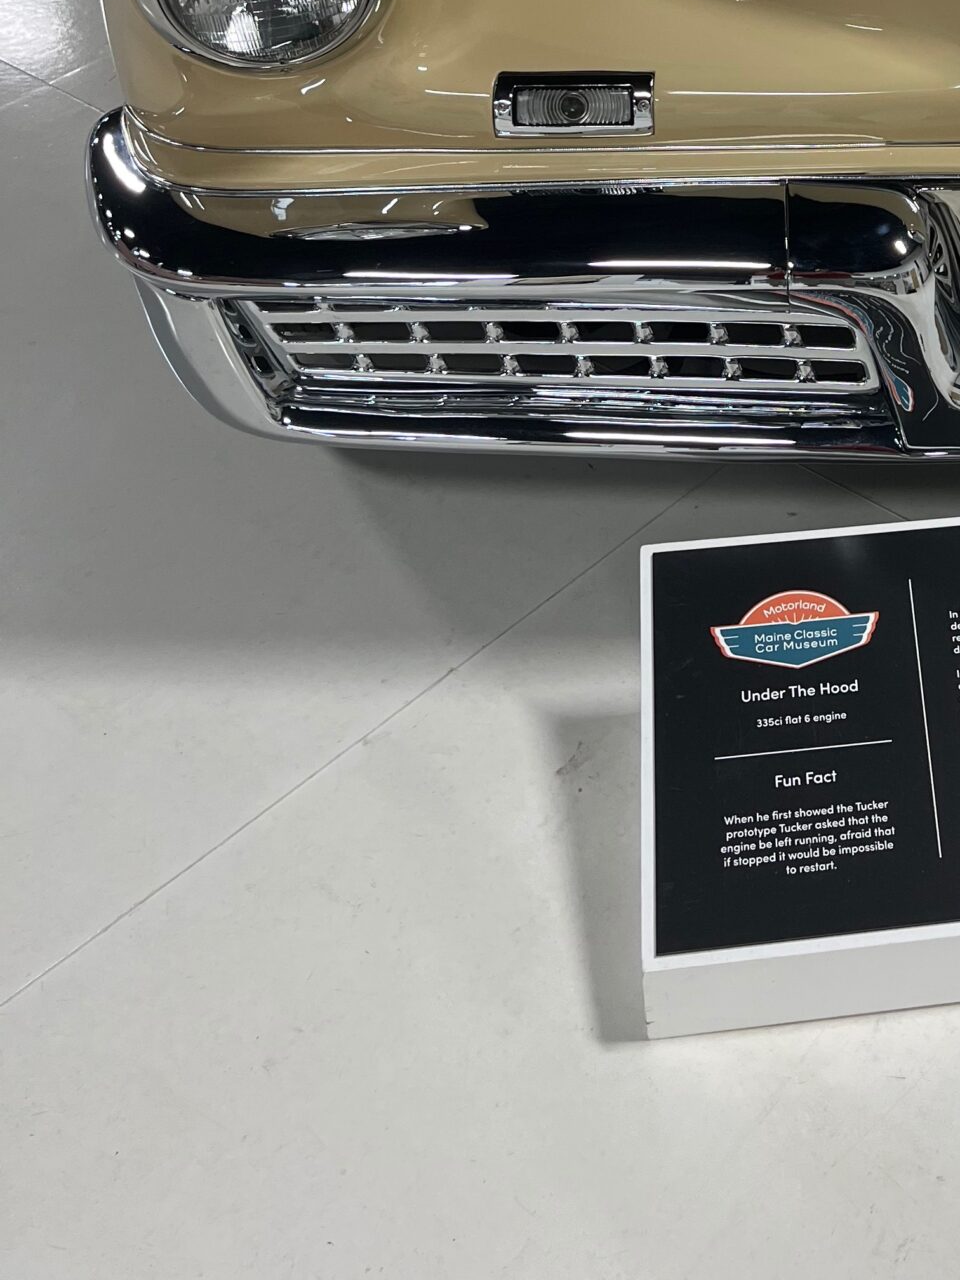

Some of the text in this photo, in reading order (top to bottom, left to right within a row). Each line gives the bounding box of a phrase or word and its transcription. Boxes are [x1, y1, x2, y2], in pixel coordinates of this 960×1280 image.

[763, 600, 826, 618] Motorland
[754, 627, 837, 643] Maine Classic
[755, 638, 838, 653] Car Museum
[741, 679, 858, 702] Under The Hood
[756, 711, 846, 727] 335ci flat 6 engine
[774, 769, 836, 787] Fun Fact
[723, 800, 888, 825] When first showed the Tucker
[725, 813, 888, 841] prototype Tucker asked that the
[720, 826, 895, 854] engine left running, afraid that
[733, 840, 893, 867] stopped would impossible
[799, 860, 837, 873] restart.
